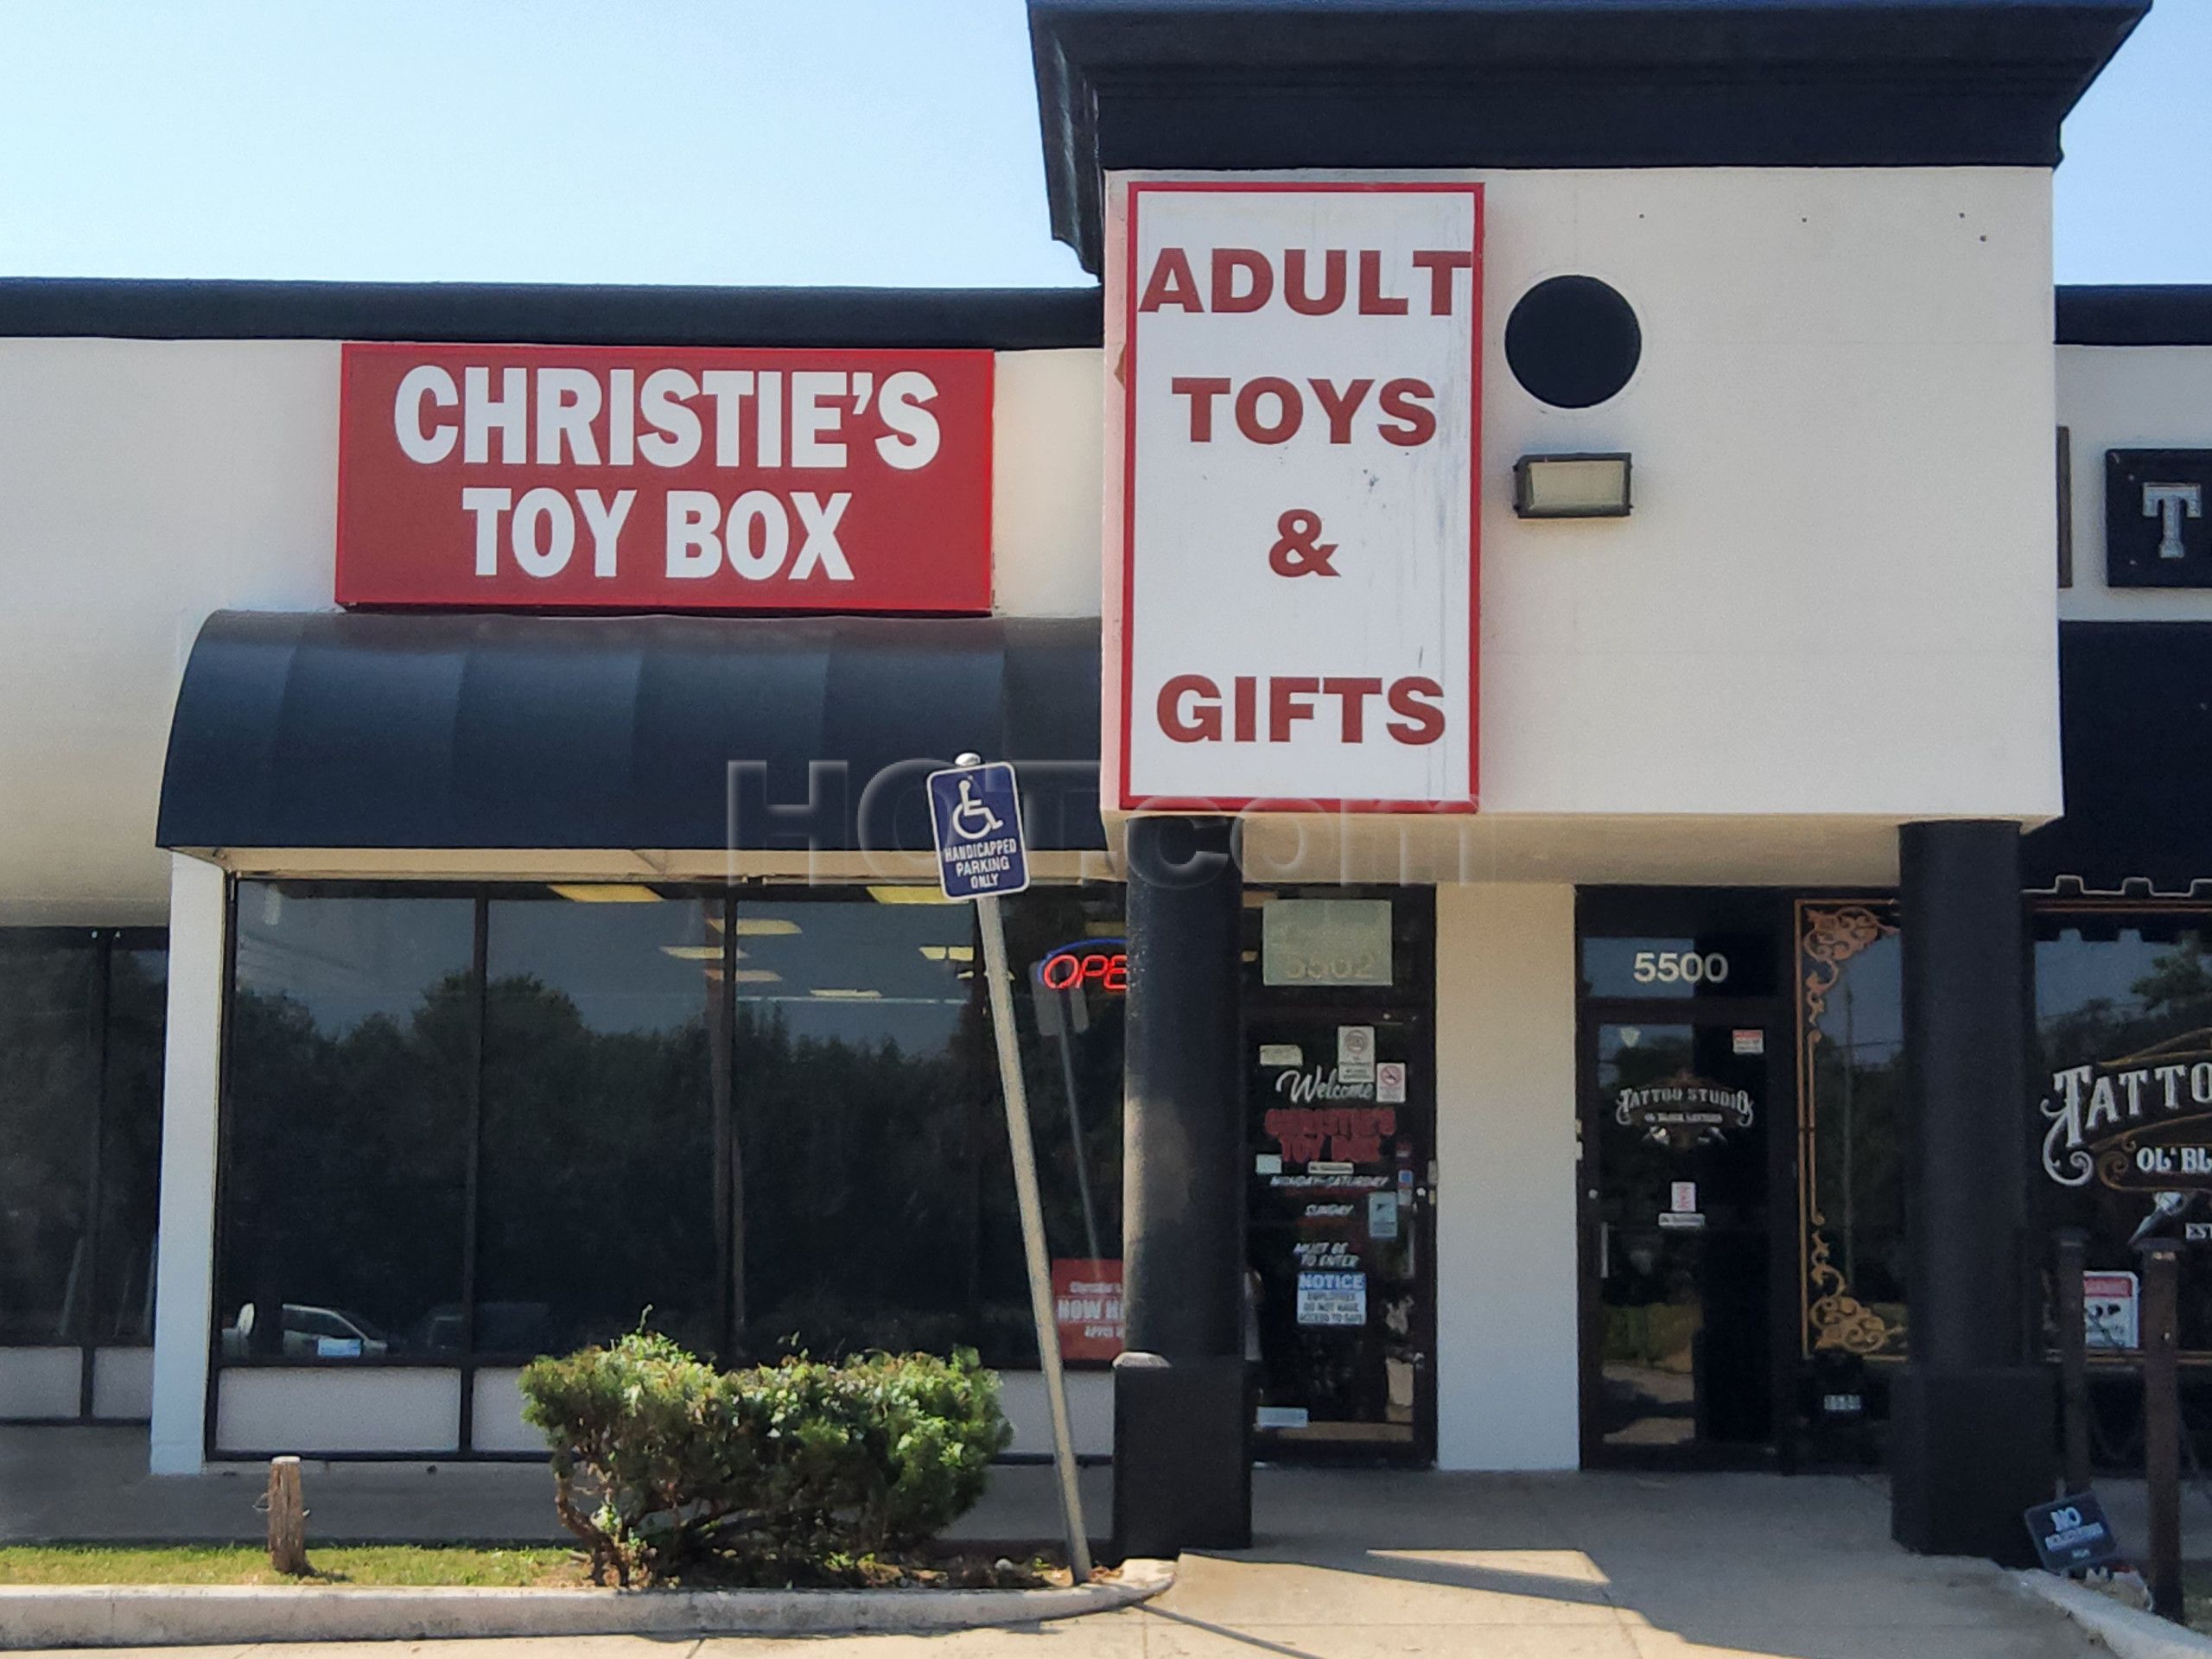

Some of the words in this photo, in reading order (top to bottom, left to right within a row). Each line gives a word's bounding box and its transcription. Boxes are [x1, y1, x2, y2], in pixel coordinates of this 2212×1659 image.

[1139, 248, 1473, 316] ADULT
[394, 365, 941, 470] CHRISTIE'S
[1172, 377, 1437, 447] TOYS
[462, 487, 637, 578] TOY
[665, 490, 855, 581] BOX
[1268, 509, 1341, 577] &
[1157, 674, 1446, 745] GIFTS
[944, 838, 1017, 862] HANDICAPPED
[956, 856, 1010, 877] PARKING
[970, 874, 1000, 889] ONLY
[1634, 952, 1728, 983] 5500
[1275, 1065, 1375, 1103] Welcome
[1687, 1088, 1753, 1127] STUDIO
[1300, 1274, 1365, 1289] NOTICE
